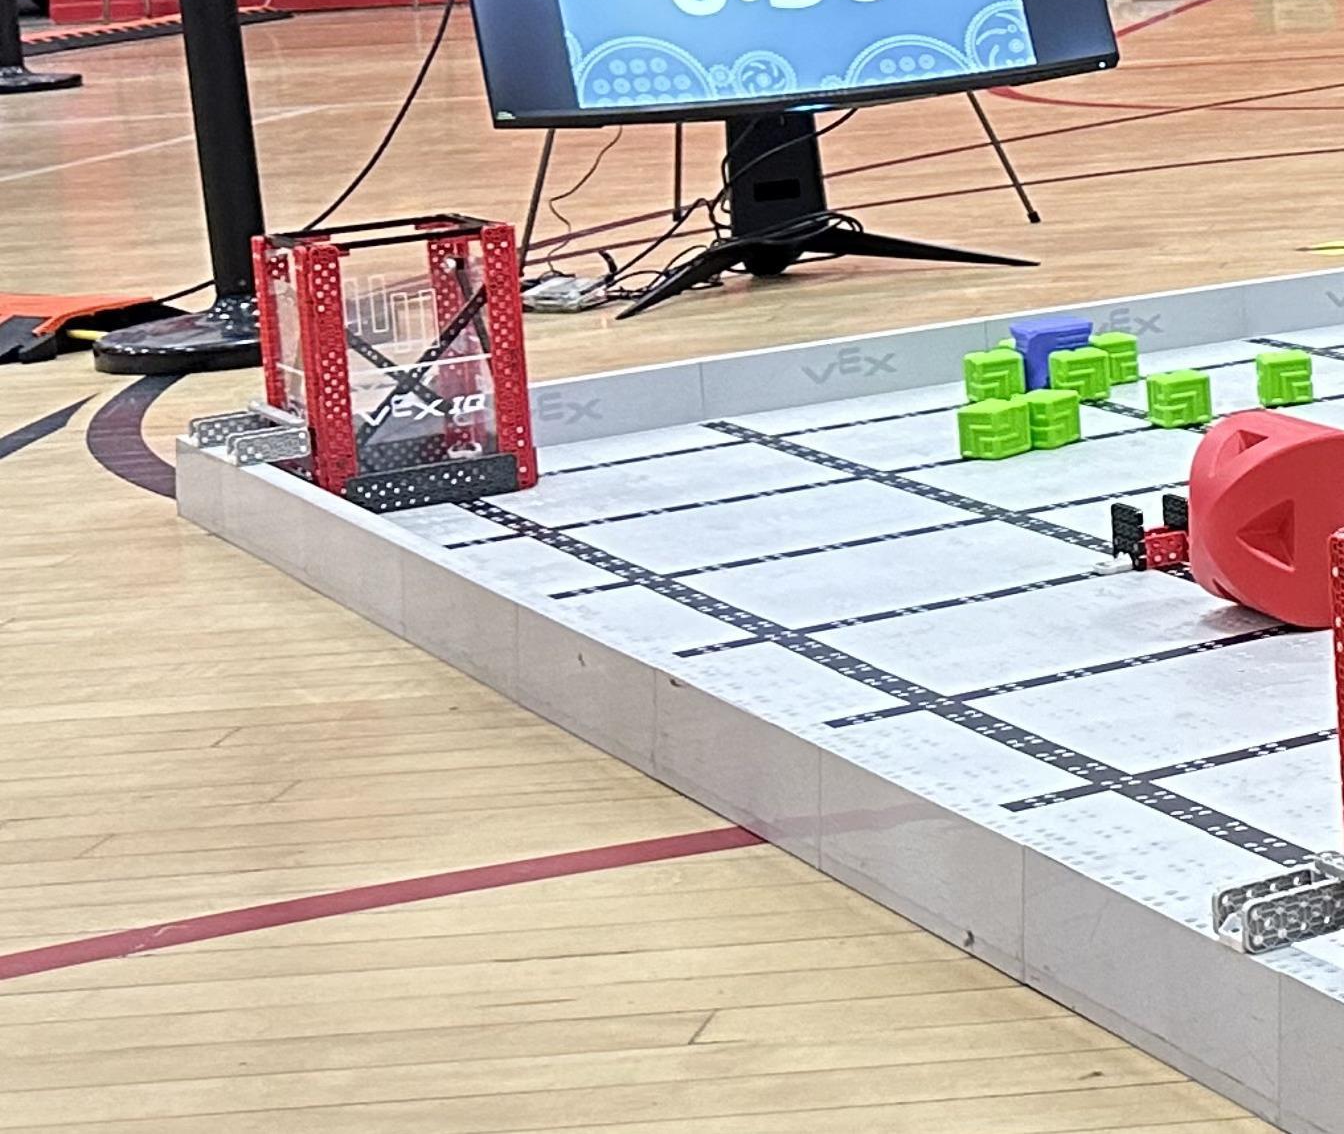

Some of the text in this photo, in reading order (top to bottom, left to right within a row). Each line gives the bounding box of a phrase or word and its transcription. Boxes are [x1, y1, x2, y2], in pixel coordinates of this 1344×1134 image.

[801, 347, 897, 384] VEX
[354, 393, 485, 426] VEX IQ
[537, 390, 600, 424] EX
